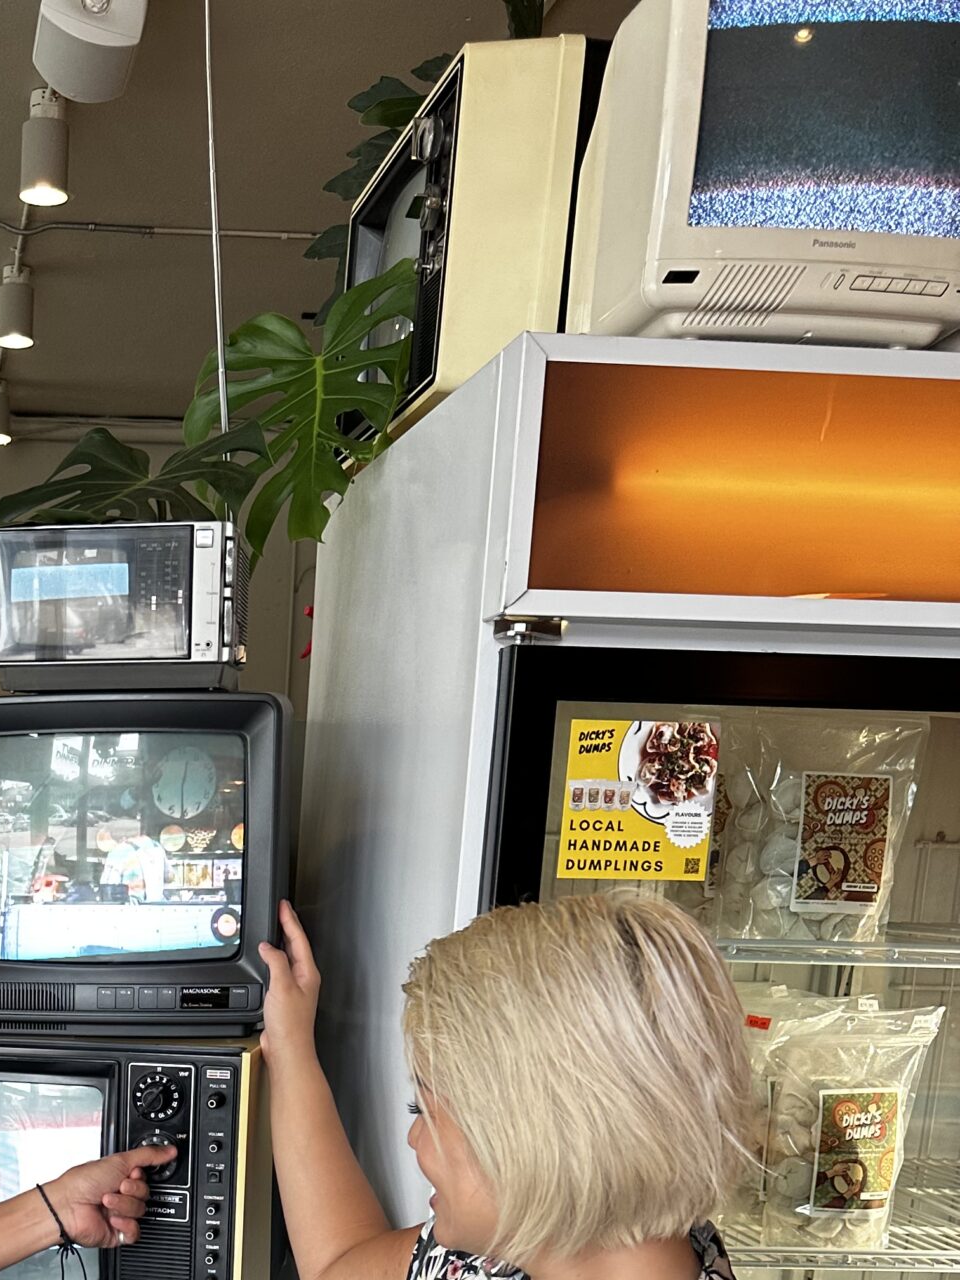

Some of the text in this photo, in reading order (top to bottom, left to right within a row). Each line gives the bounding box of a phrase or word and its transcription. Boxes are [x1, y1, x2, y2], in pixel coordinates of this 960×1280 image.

[812, 238, 856, 249] Panasonic
[578, 729, 616, 741] DICKY'S
[578, 742, 613, 754] DUMPS
[824, 796, 870, 811] DICKY'S
[827, 810, 869, 825] DUMPS
[569, 819, 624, 832] LOCAL
[567, 839, 661, 852] HANDMADE
[565, 858, 664, 872] DUMPLINGS
[842, 1111, 882, 1127] DICKY'S
[845, 1124, 882, 1140] DUMPS
